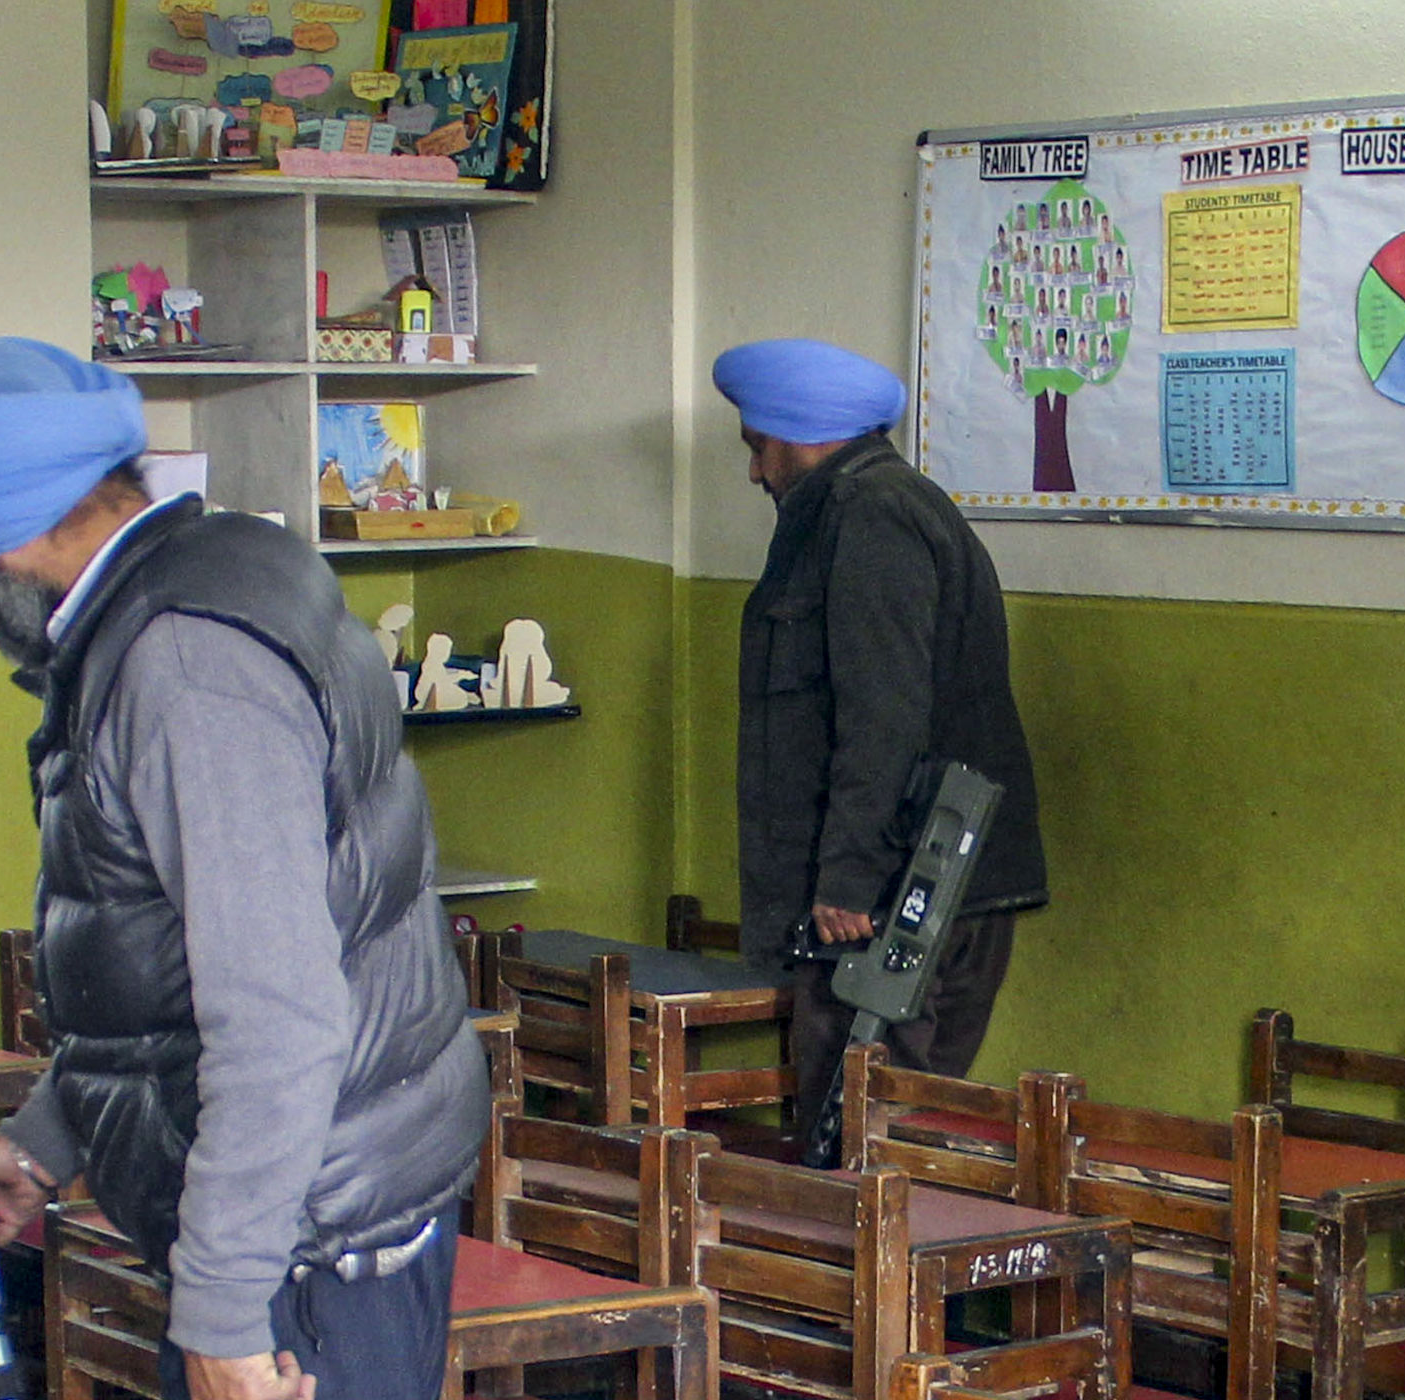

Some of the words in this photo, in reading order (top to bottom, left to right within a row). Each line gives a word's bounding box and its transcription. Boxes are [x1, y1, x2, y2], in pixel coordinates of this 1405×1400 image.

[983, 144, 1037, 175] FAMILY
[1042, 143, 1083, 172] TREE
[1183, 151, 1232, 180] TIME
[1238, 142, 1308, 174] TABLE
[1233, 191, 1282, 205] TIMETABLE
[1190, 357, 1235, 368] TEACHER'S
[1237, 355, 1286, 367] TIMETABLE
